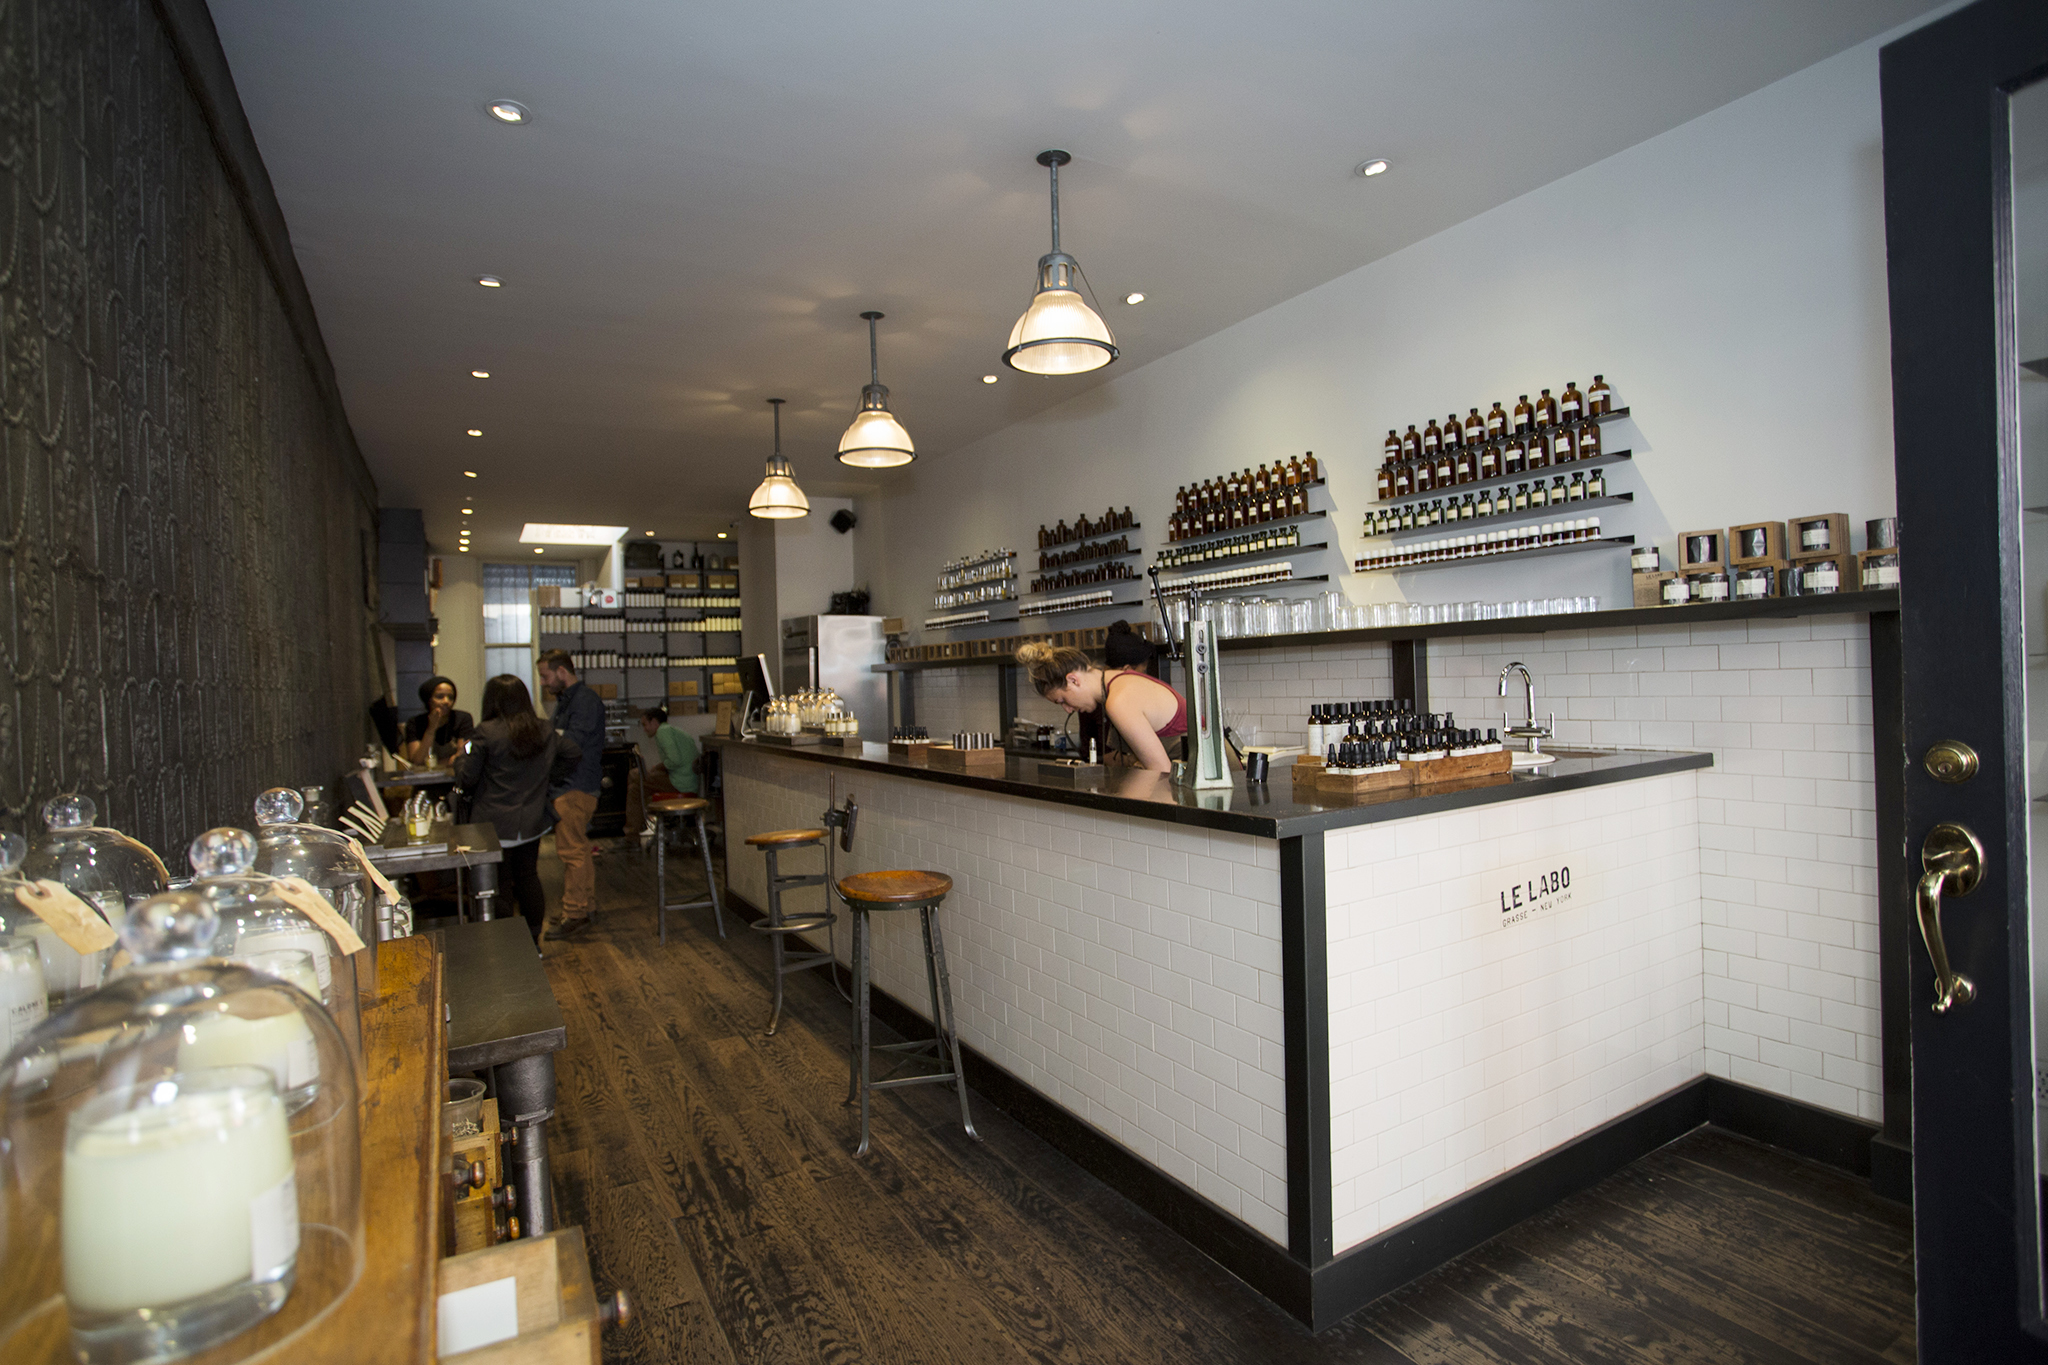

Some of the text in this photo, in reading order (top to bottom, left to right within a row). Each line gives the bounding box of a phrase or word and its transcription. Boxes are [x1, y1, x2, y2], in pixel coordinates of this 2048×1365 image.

[1501, 866, 1570, 913] LE LABO
[1502, 910, 1528, 928] GRASSE
[1540, 901, 1553, 911] NEW
[1556, 892, 1572, 904] YORK
